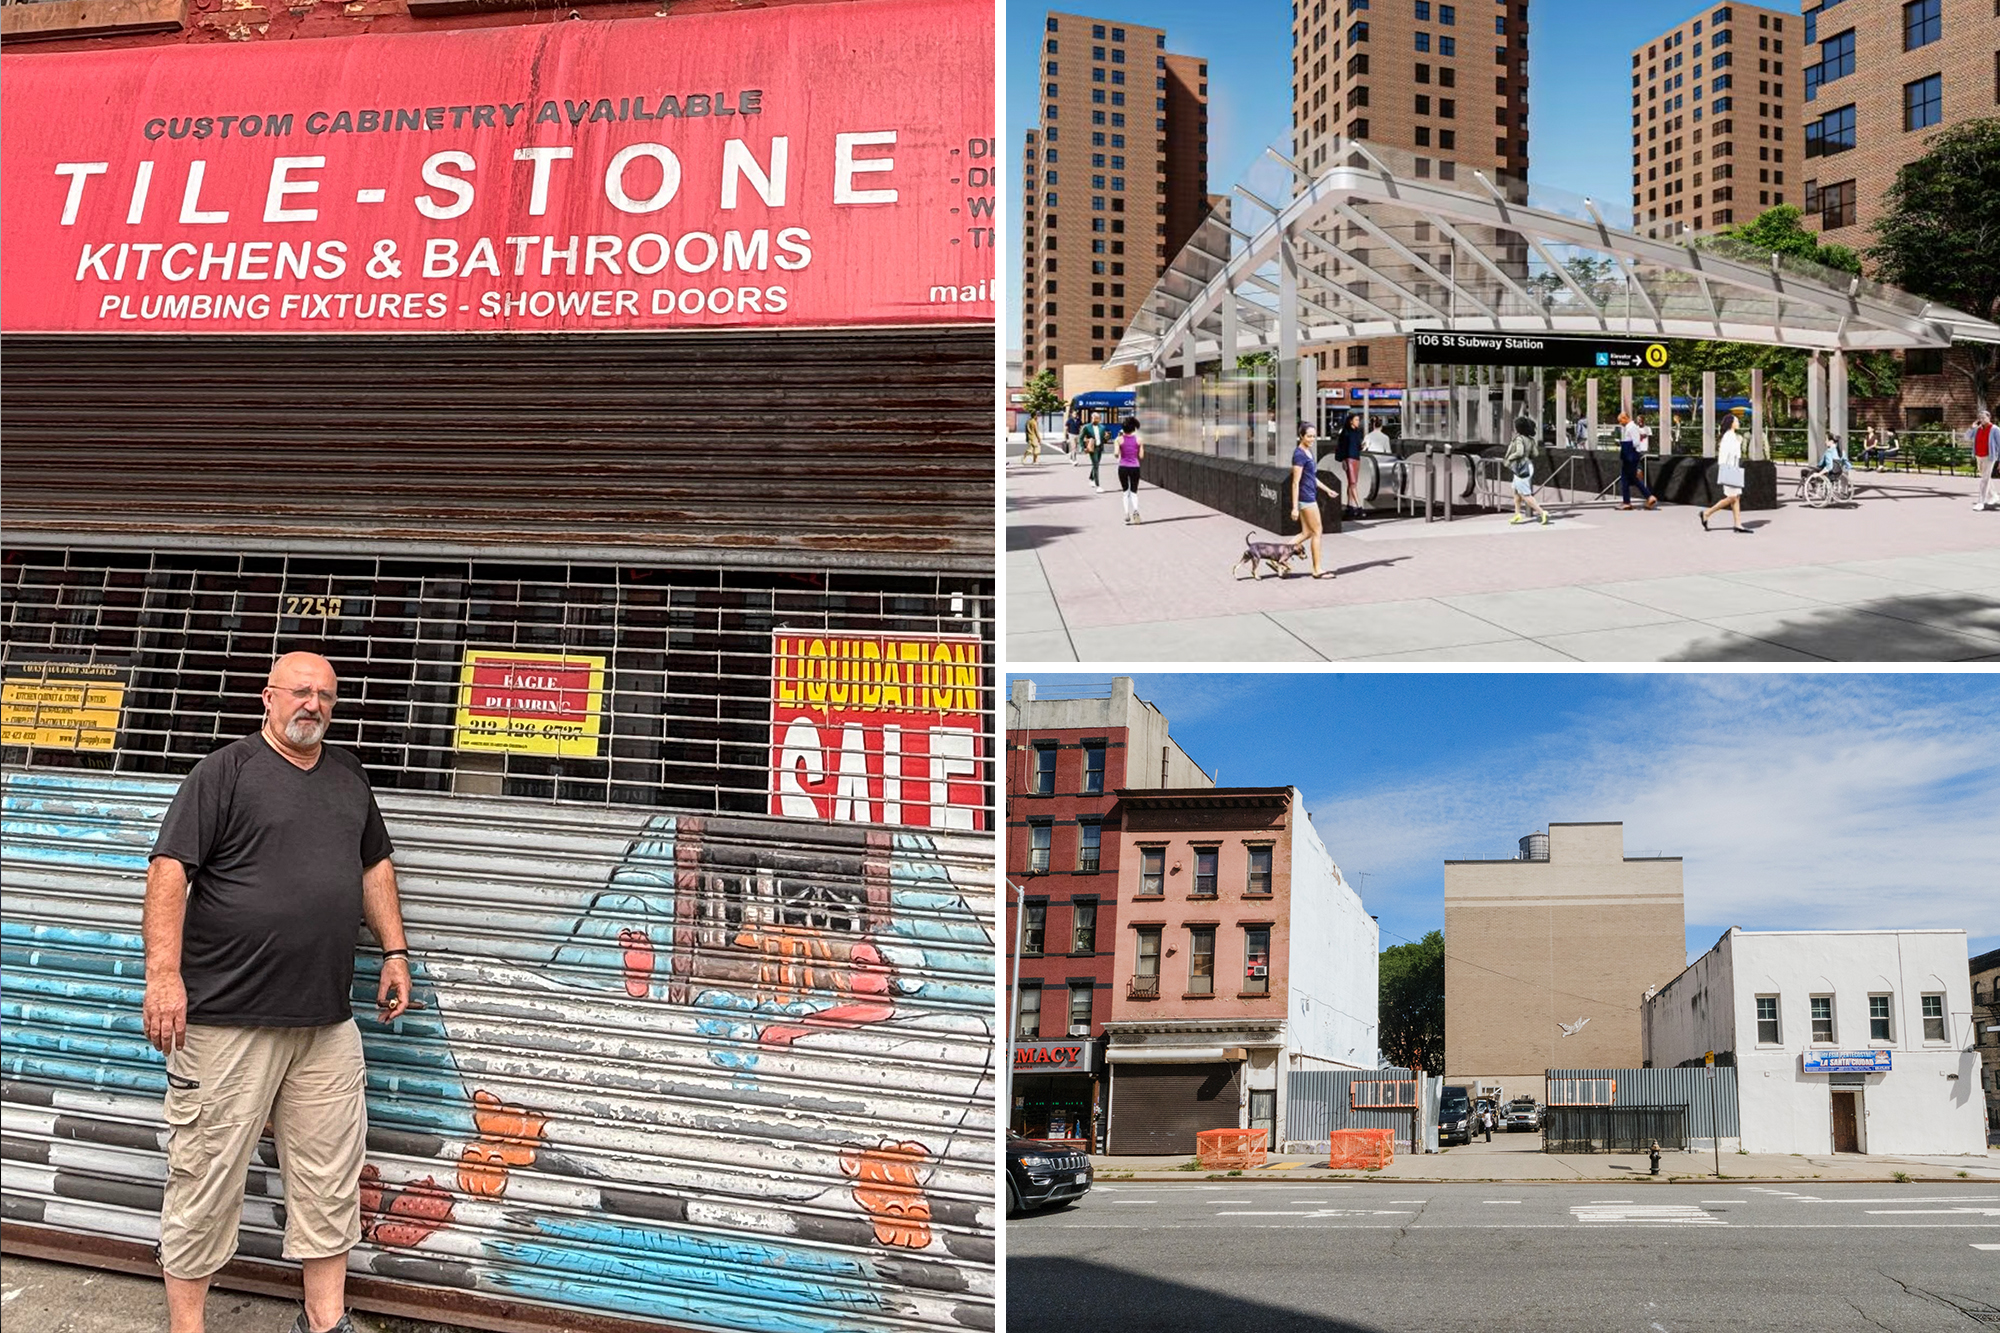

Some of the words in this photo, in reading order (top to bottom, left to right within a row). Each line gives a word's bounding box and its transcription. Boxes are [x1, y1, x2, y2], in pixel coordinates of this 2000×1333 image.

[143, 112, 293, 140] CUSTOM
[305, 103, 524, 134] CABINETRY
[536, 89, 763, 124] AVAILABLE
[75, 240, 348, 281] KITCHENS
[365, 238, 402, 279] &
[421, 226, 813, 279] BATHROOMS
[98, 293, 270, 319] PLUMBING
[280, 292, 449, 319] FIXTURES
[478, 288, 639, 318] SHOWER
[651, 285, 788, 315] DOORS
[1416, 335, 1439, 346] 106
[1442, 336, 1455, 346] St
[1458, 337, 1502, 350] Subway
[1505, 338, 1543, 349] Station
[1650, 348, 1664, 363] Q
[503, 674, 558, 689] EAGLE
[778, 638, 977, 716] LIQUIDATION
[1006, 1047, 1081, 1063] MACY
